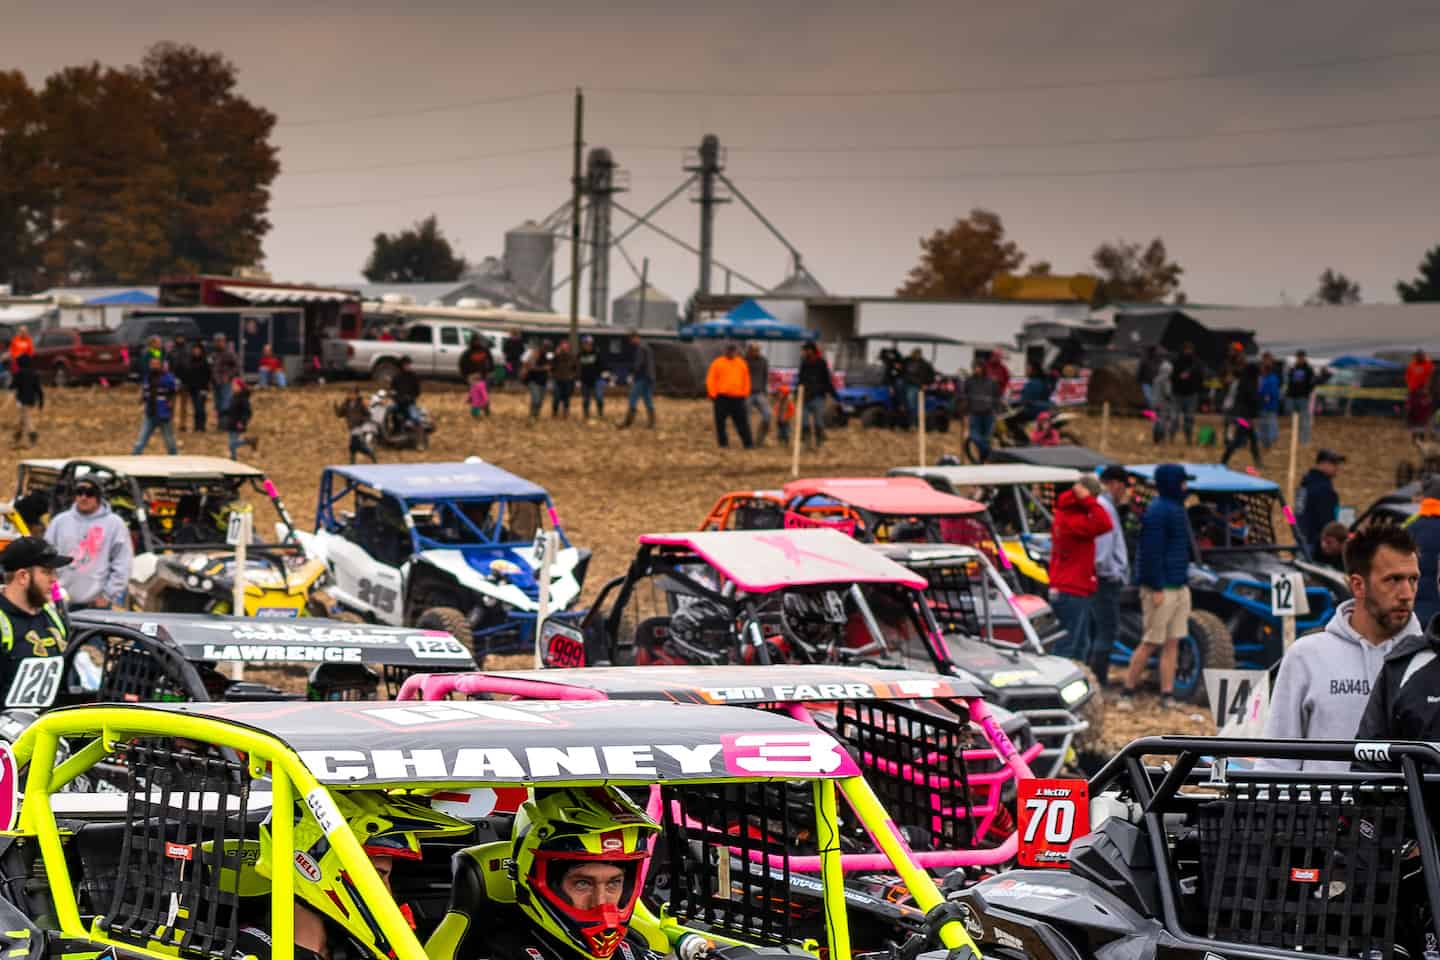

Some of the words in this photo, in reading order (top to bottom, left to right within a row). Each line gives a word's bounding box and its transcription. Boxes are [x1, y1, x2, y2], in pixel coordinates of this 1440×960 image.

[1274, 577, 1292, 610] 12
[203, 644, 362, 662] LAWRENCE
[9, 661, 58, 705] 126
[772, 682, 875, 700] FARR
[1216, 678, 1252, 728] 14
[312, 743, 725, 779] CHANEY
[734, 732, 842, 775] 3
[1023, 799, 1076, 843] 70
[295, 853, 317, 878] BELL
